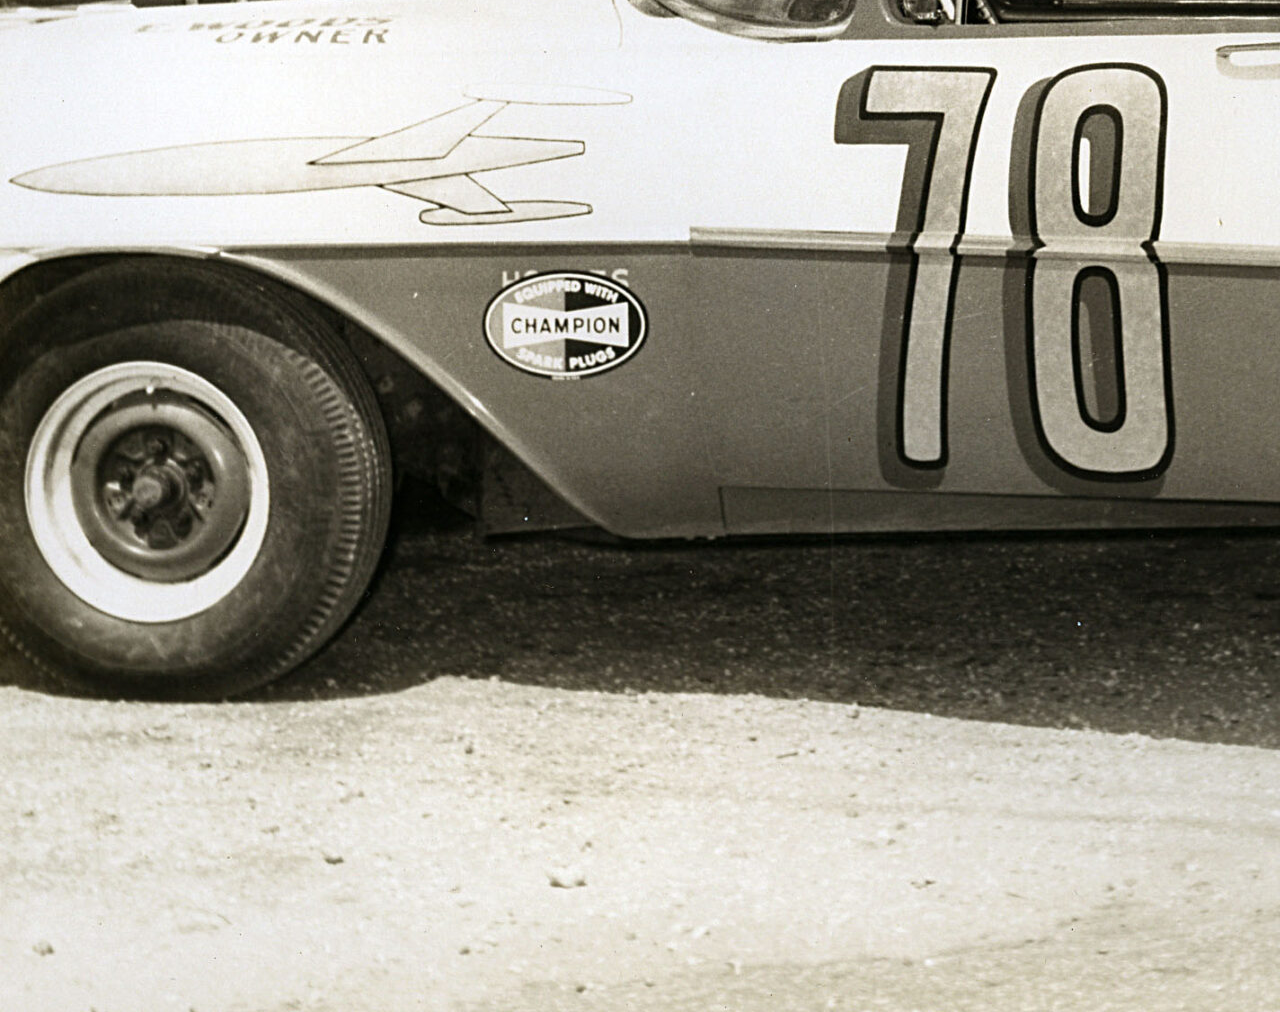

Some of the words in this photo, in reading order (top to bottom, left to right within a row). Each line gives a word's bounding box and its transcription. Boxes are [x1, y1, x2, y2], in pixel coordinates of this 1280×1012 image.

[216, 29, 391, 44] OWNER
[834, 62, 1175, 490] 78
[514, 280, 582, 303] EQUIPPED
[584, 281, 618, 303] WITH
[511, 317, 620, 334] CHAMPION
[516, 348, 564, 370] SPARK
[569, 346, 616, 369] PLUGS
